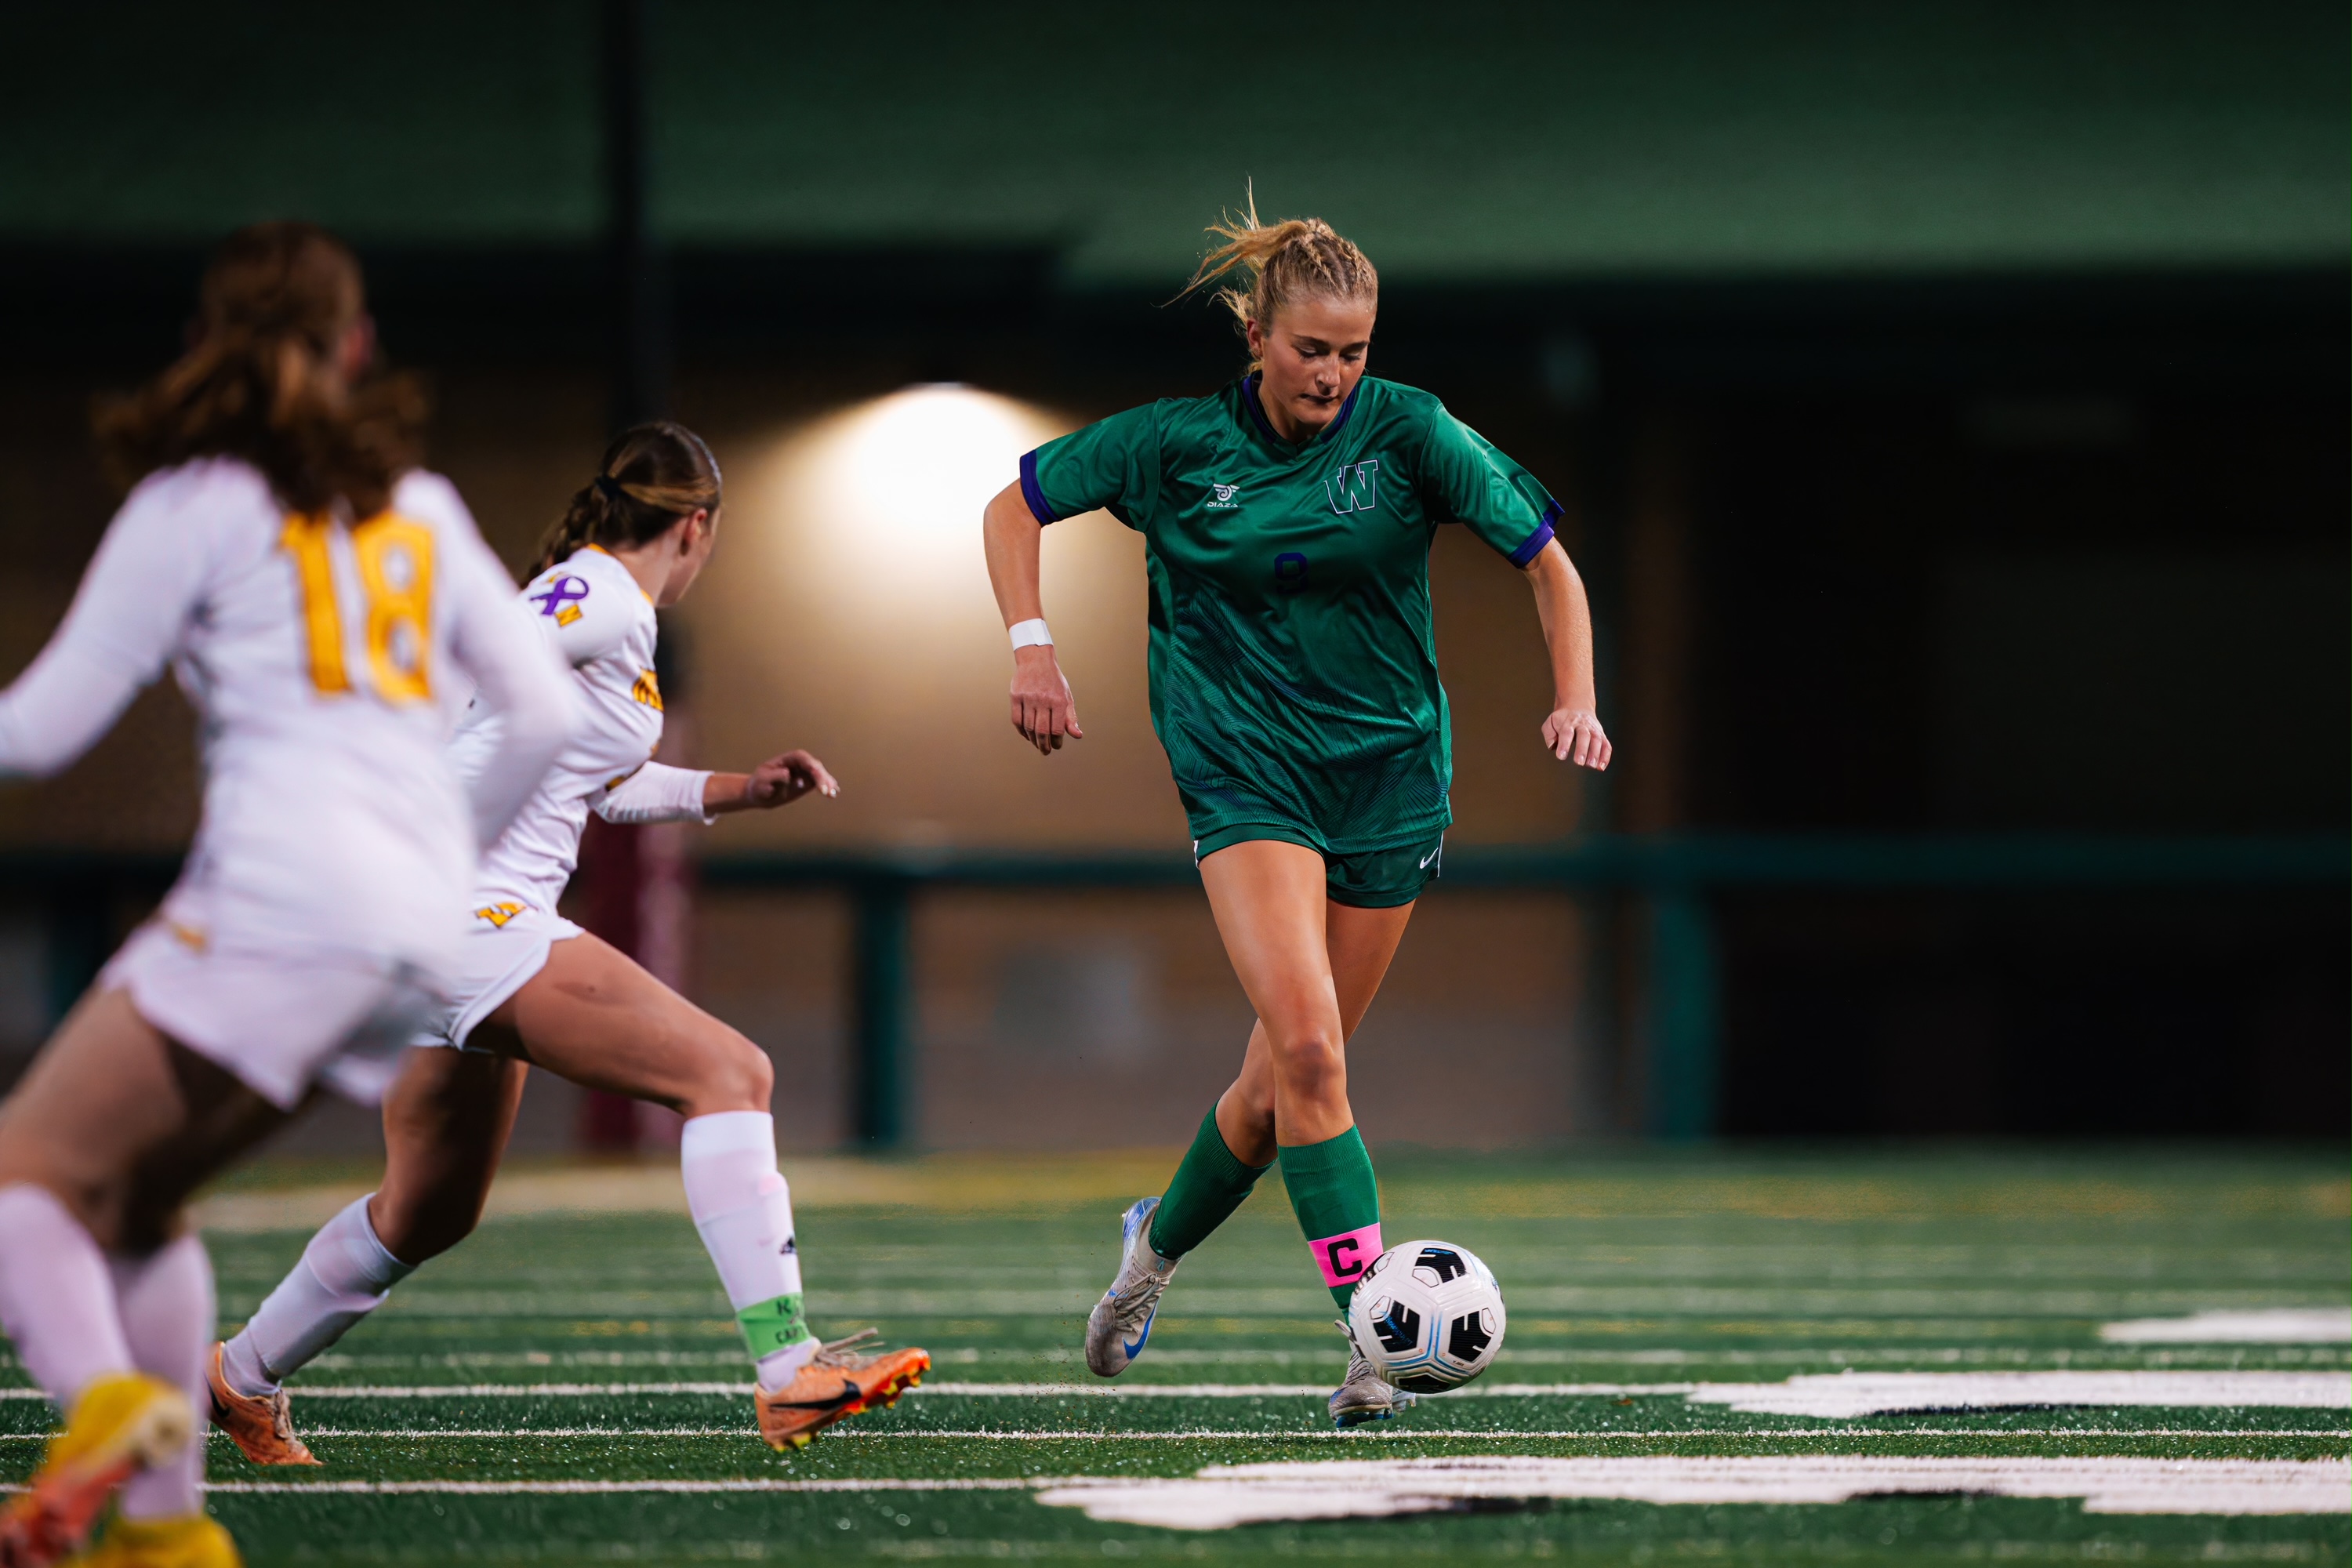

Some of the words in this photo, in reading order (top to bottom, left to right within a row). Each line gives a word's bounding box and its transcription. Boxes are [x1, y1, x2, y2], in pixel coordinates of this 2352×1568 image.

[1323, 459, 1378, 514] W
[1274, 552, 1308, 595] 9
[278, 511, 437, 706] 18
[1327, 1237, 1363, 1278] C
